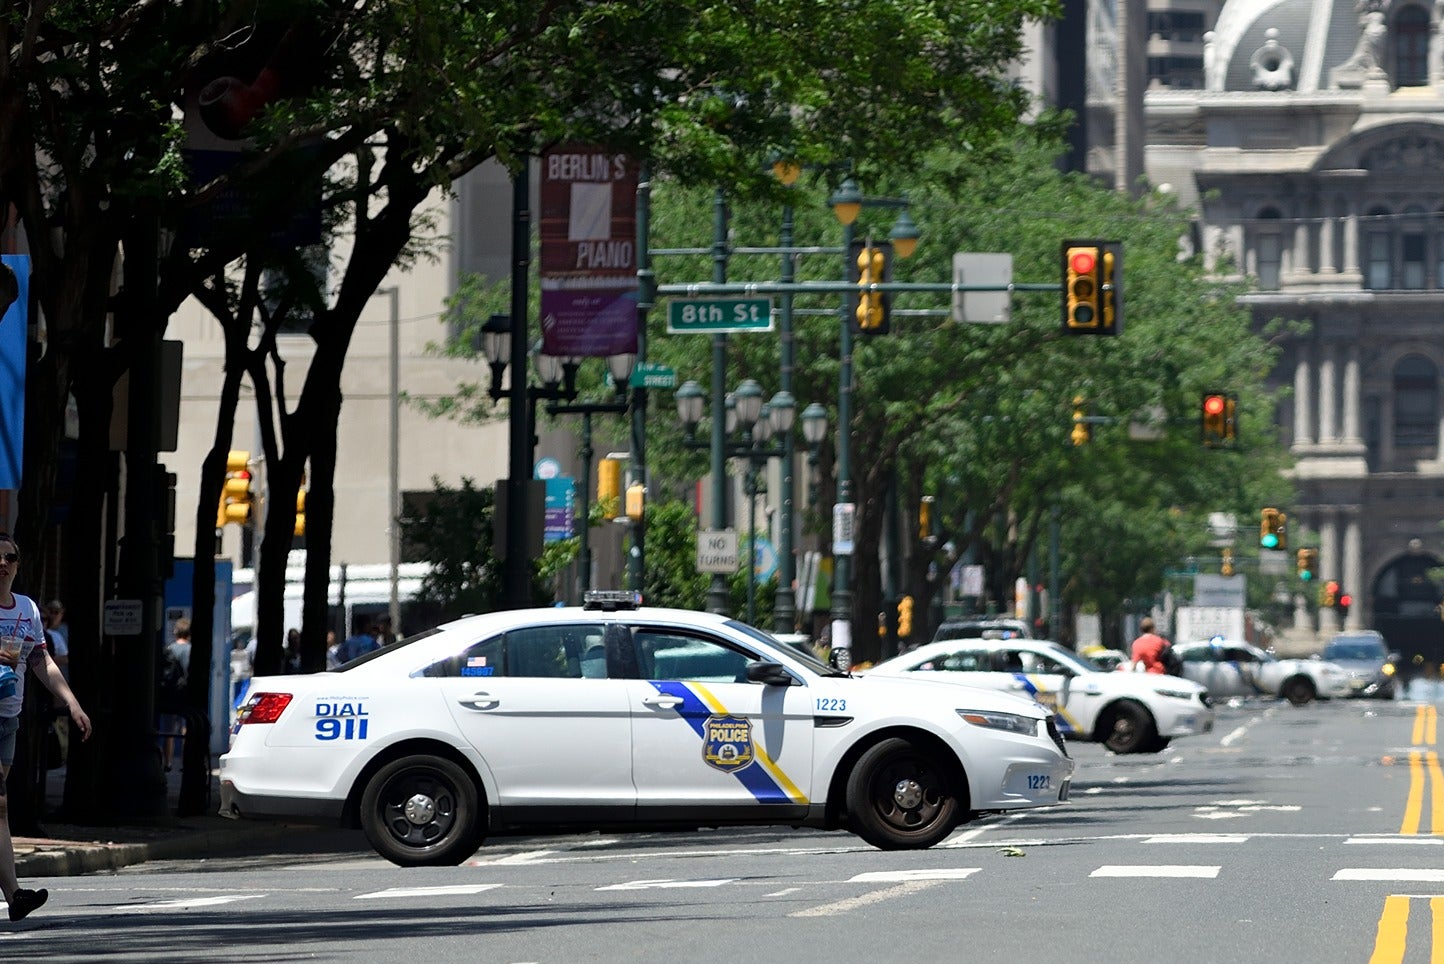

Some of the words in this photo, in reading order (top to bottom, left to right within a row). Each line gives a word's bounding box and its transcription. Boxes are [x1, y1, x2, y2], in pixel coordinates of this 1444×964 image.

[547, 153, 627, 181] BERLINS
[576, 241, 633, 269] PIANO
[681, 303, 724, 324] 8th
[733, 303, 761, 323] St
[708, 537, 726, 550] NO
[699, 554, 736, 567] TURNS
[315, 703, 369, 717] DIAL
[816, 698, 847, 712] 1223
[314, 718, 369, 741] 911
[710, 729, 749, 743] POLICE
[1027, 775, 1051, 790] 1223
